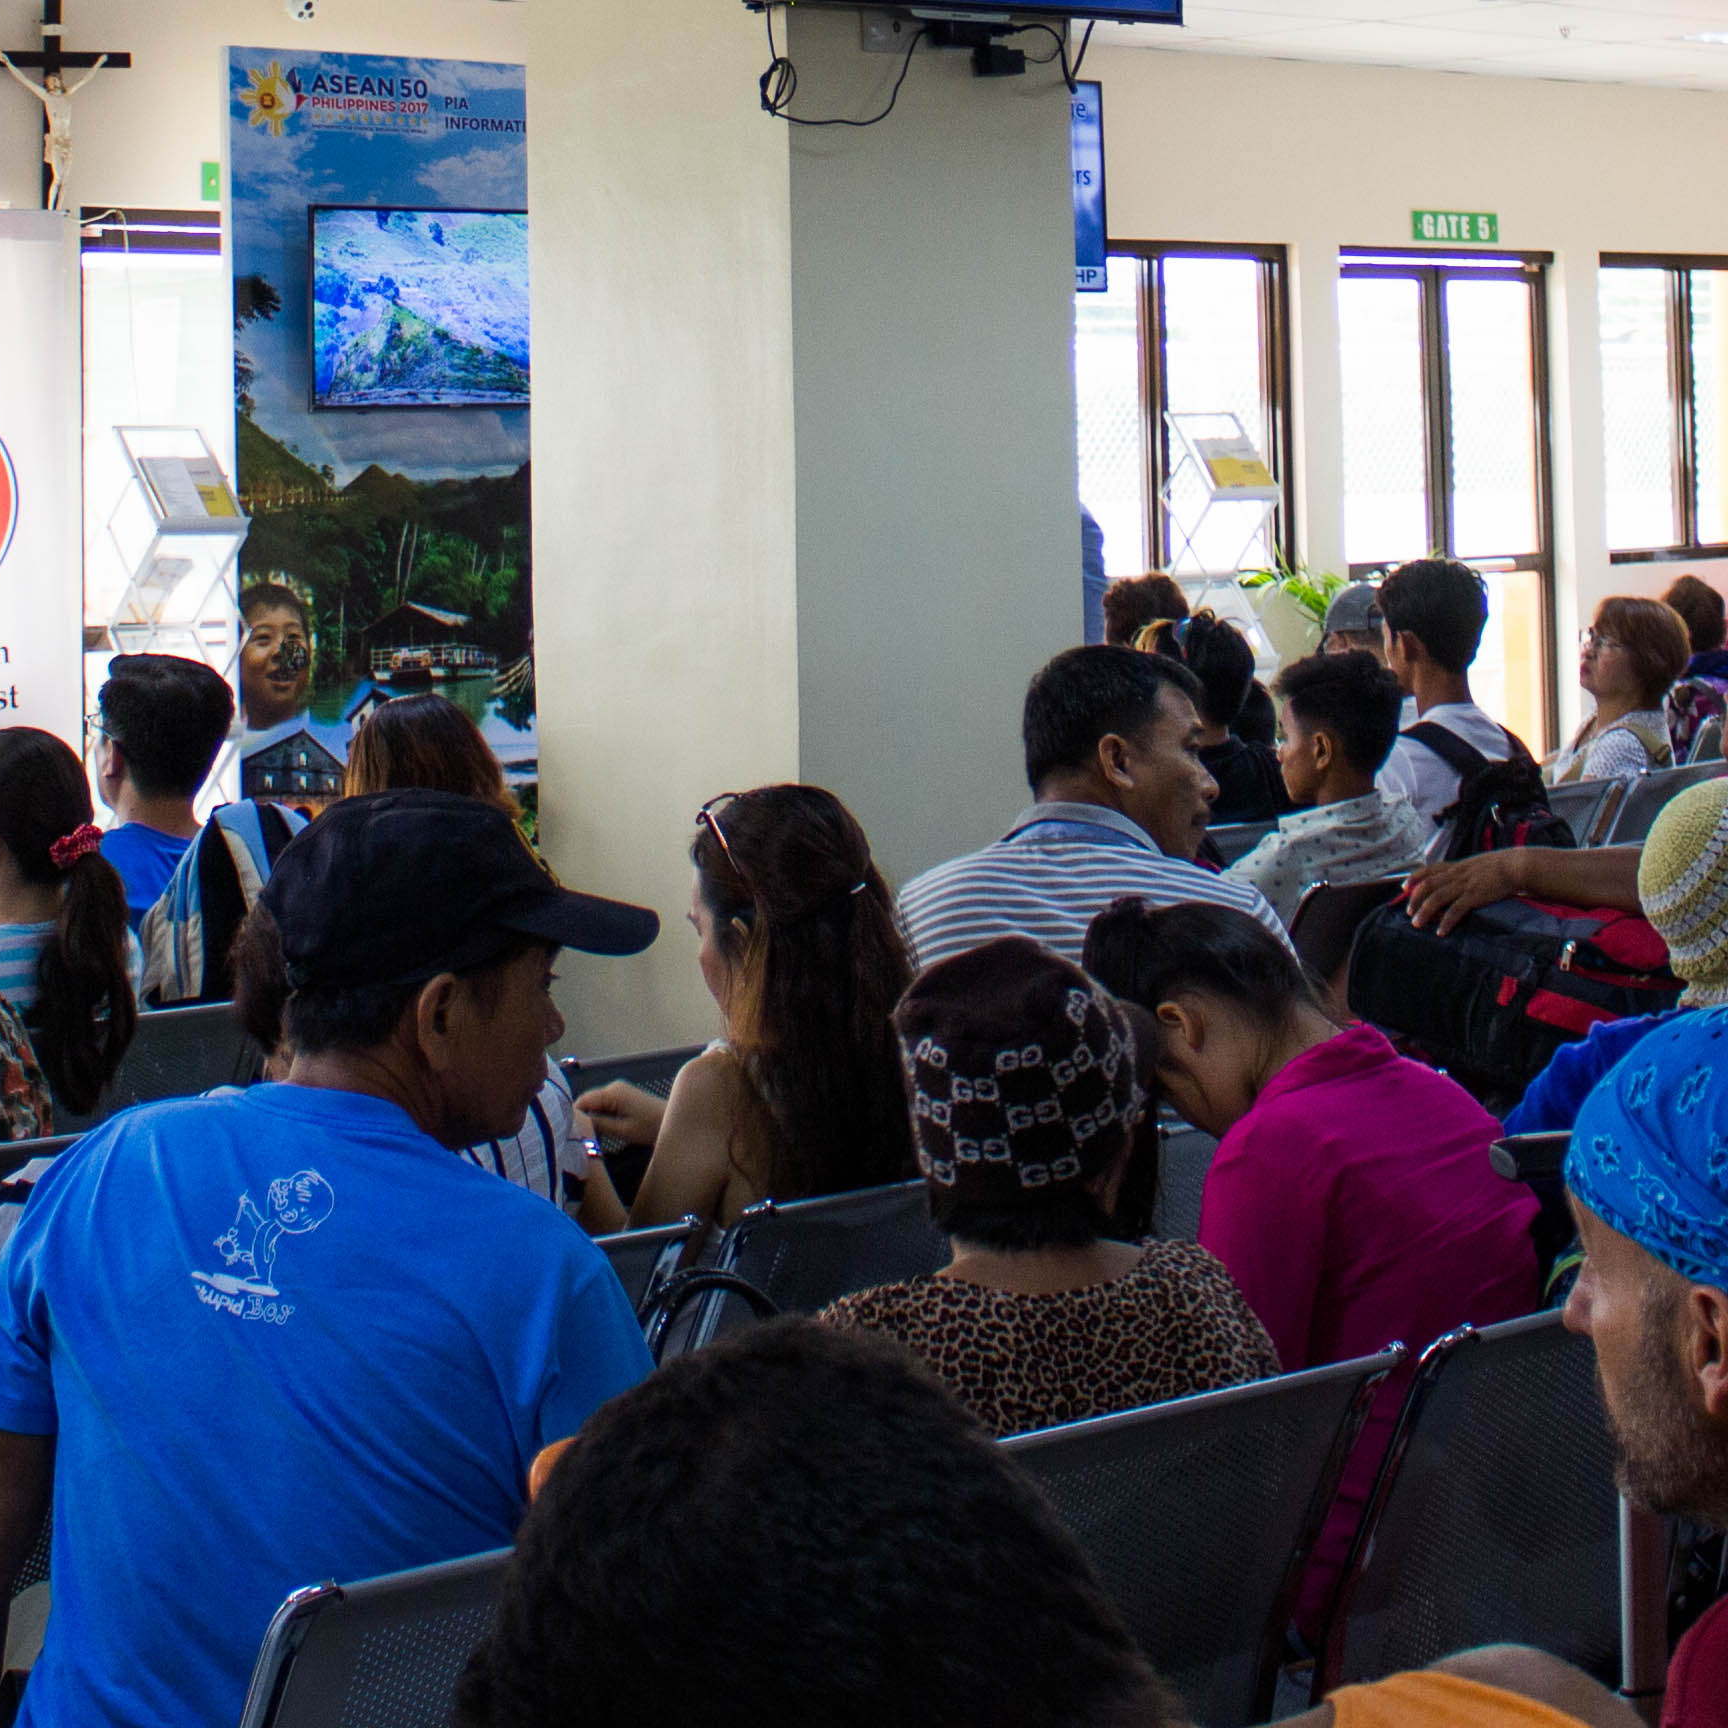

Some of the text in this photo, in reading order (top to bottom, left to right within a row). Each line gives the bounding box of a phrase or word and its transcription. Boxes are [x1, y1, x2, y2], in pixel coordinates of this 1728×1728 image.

[311, 73, 429, 100] ASEAN 50
[311, 96, 429, 115] PHILIPPINES 2017
[444, 95, 469, 111] PIA
[444, 116, 527, 134] INFORMATI
[1422, 213, 1491, 241] GATE 5
[195, 1285, 245, 1317] tupid
